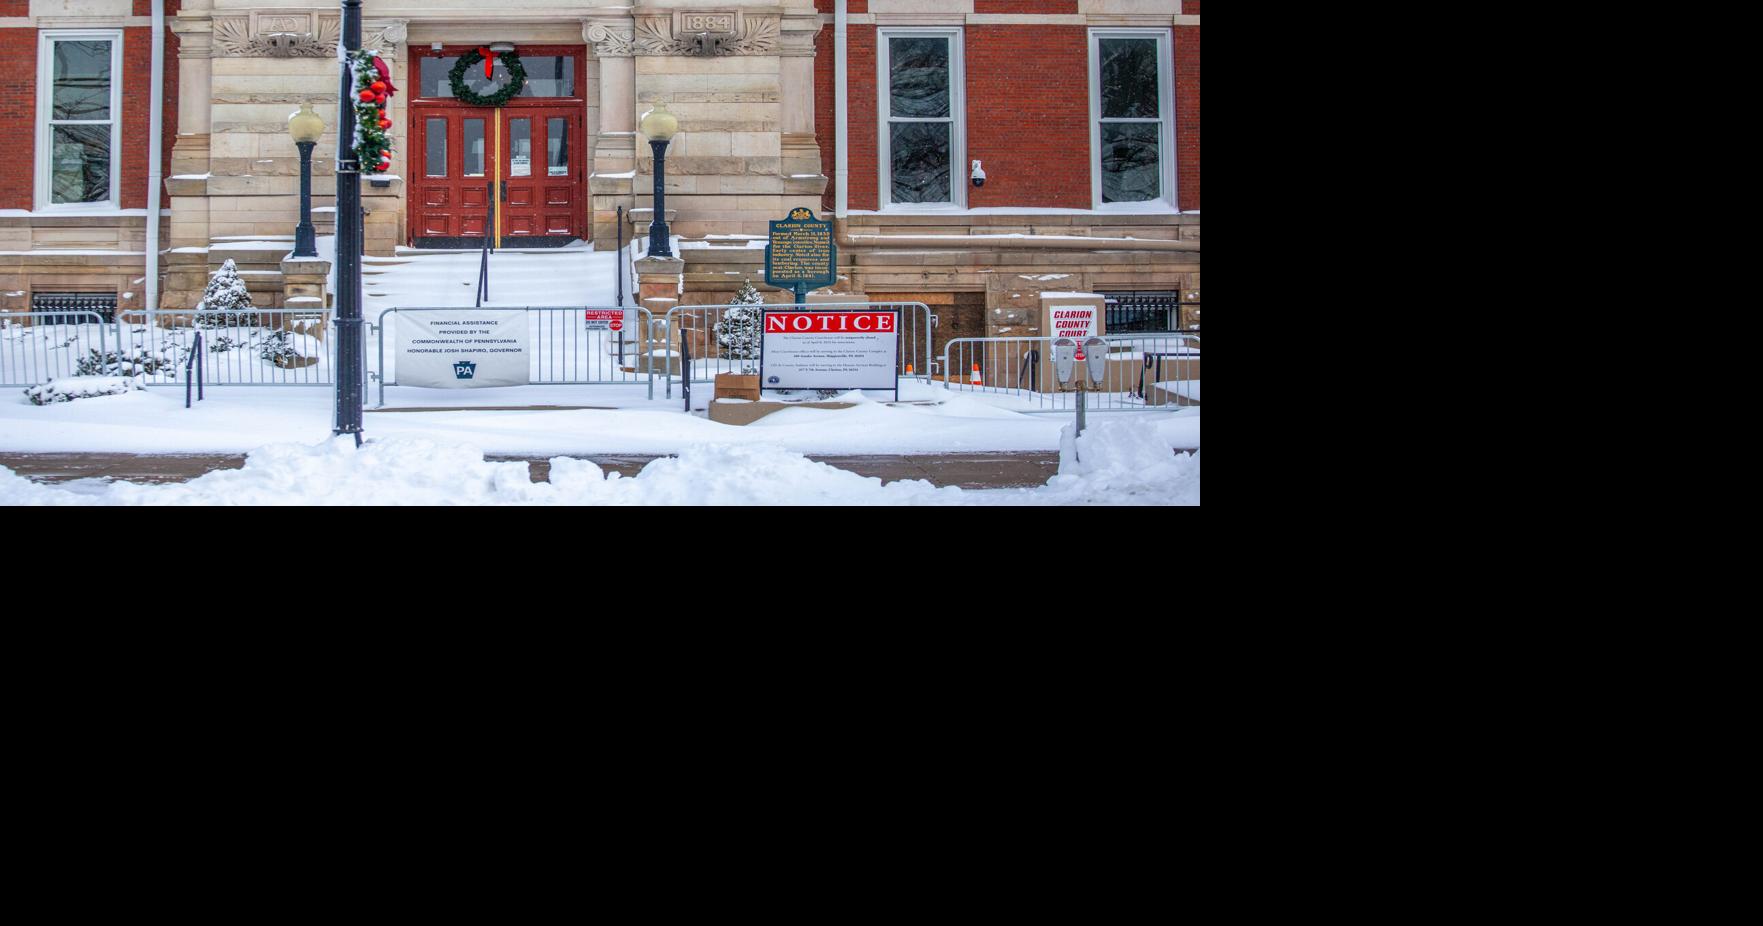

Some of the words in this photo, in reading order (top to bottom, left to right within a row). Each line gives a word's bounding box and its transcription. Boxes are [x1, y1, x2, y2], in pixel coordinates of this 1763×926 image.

[687, 15, 730, 30] 1884
[1054, 310, 1092, 319] CLARION
[768, 315, 892, 331] NOTICE
[456, 366, 473, 375] PA
